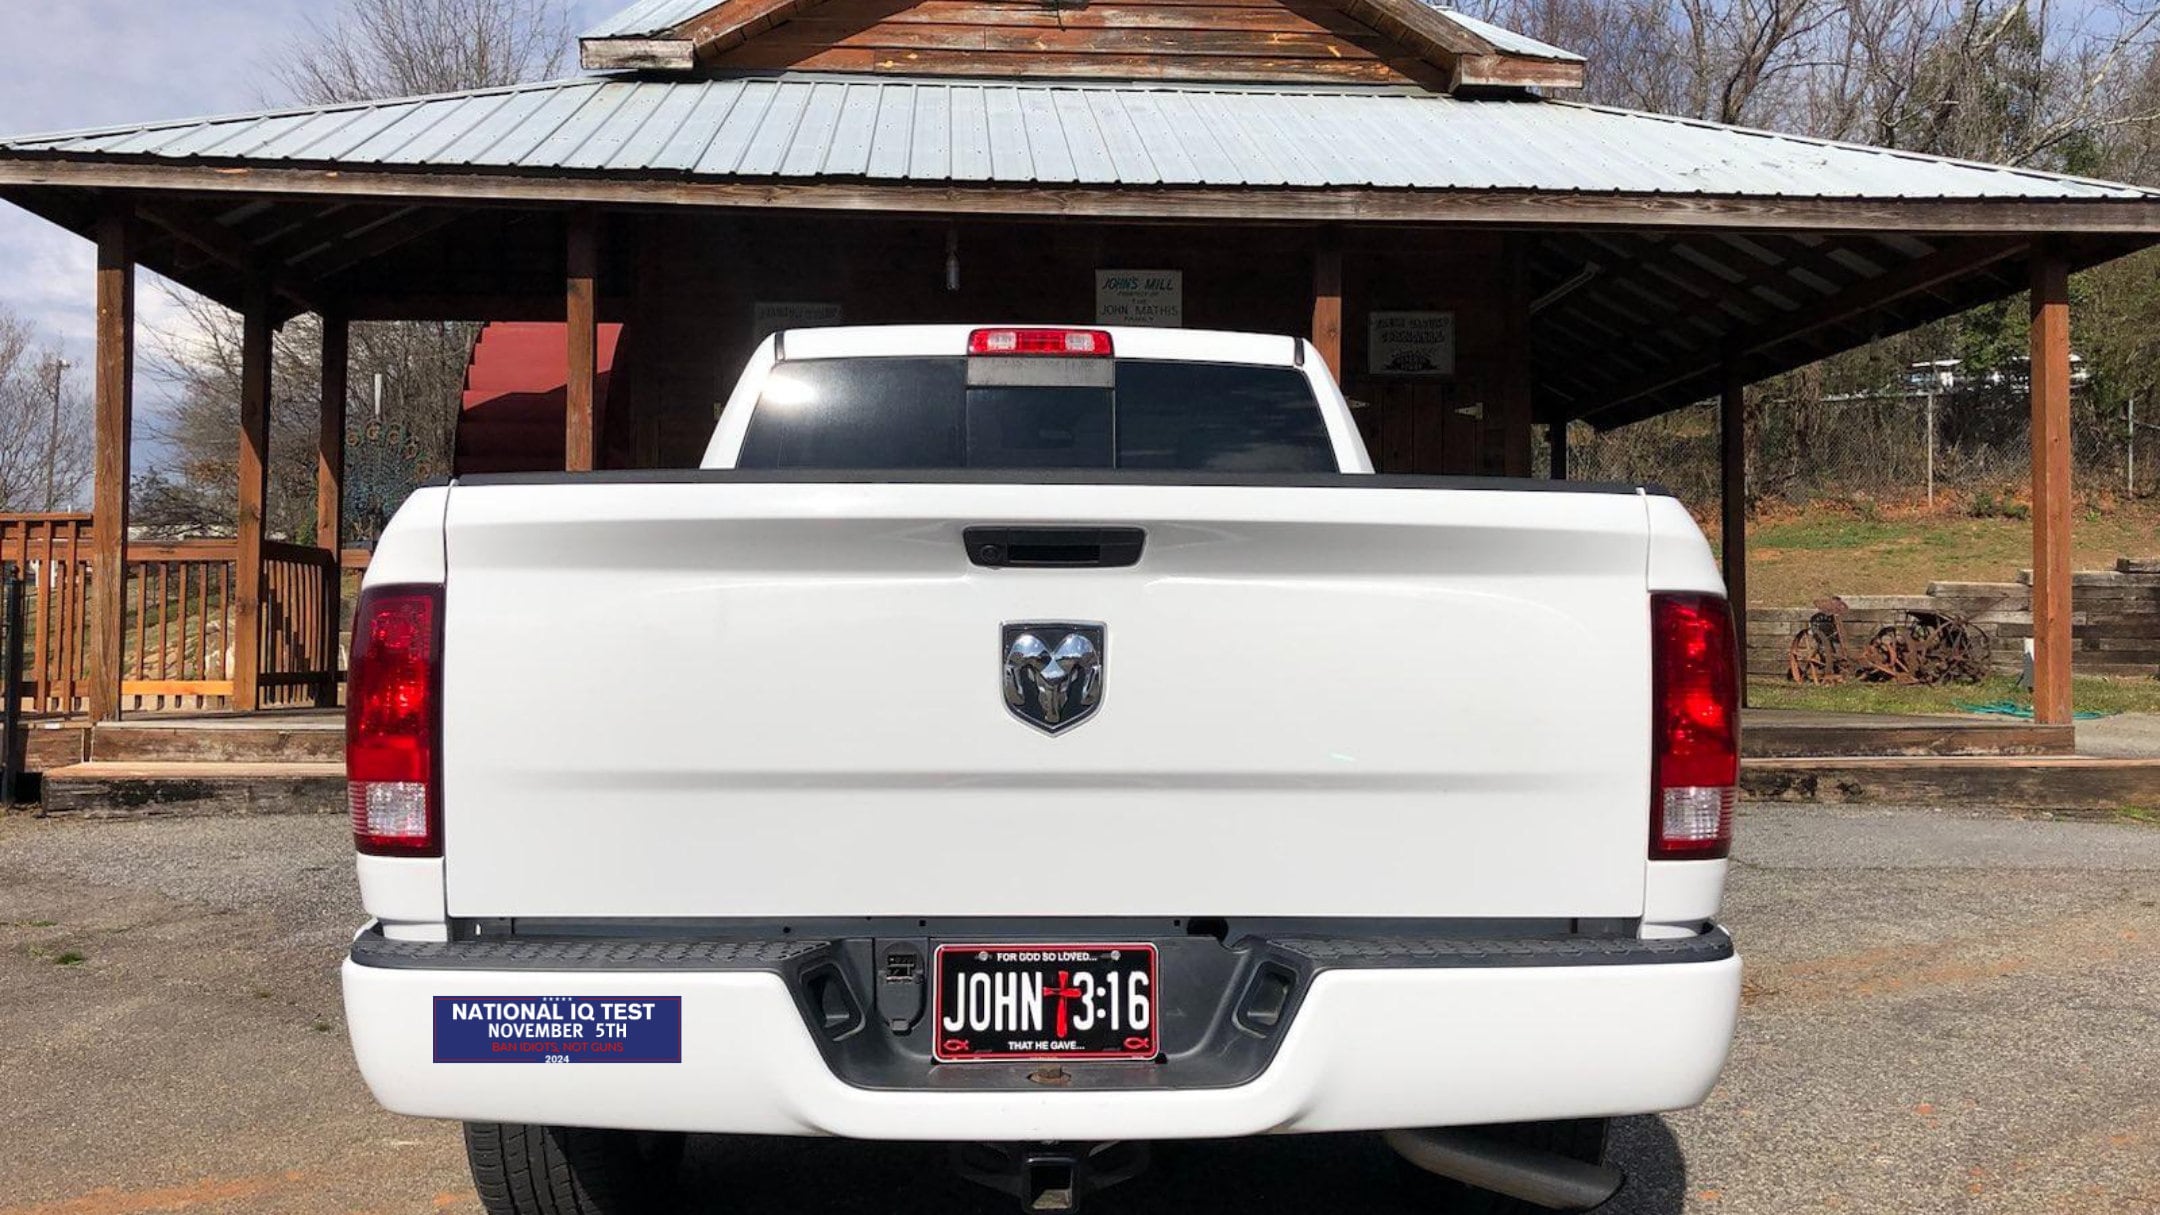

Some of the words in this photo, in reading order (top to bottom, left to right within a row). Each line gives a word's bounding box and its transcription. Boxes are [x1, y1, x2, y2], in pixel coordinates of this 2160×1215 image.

[1102, 277, 1139, 290] JOHN'S
[1144, 278, 1174, 291] MILL
[1101, 304, 1128, 316] JOHN
[1135, 305, 1178, 317] MATHIS
[996, 952, 1017, 962] FOR
[1019, 952, 1040, 962] GOD
[1042, 952, 1056, 962] SO
[1058, 952, 1097, 961] LOVED...
[943, 971, 1043, 1032] JOHN
[1072, 971, 1150, 1031] 3:16
[452, 1003, 564, 1020] NATIONAL
[571, 1003, 595, 1021] IQ
[600, 1003, 656, 1020] TEST
[488, 1023, 584, 1038] NOVEMBER
[595, 1023, 627, 1038] 5TH
[492, 1042, 517, 1053] BAN
[520, 1042, 559, 1053] IDIOTS,
[562, 1042, 588, 1053] NOT
[591, 1042, 624, 1053] GUNS
[1008, 1041, 1034, 1050] THAT
[1035, 1041, 1049, 1050] HE
[1050, 1041, 1085, 1050] GAVE...
[545, 1055, 570, 1064] 2024
